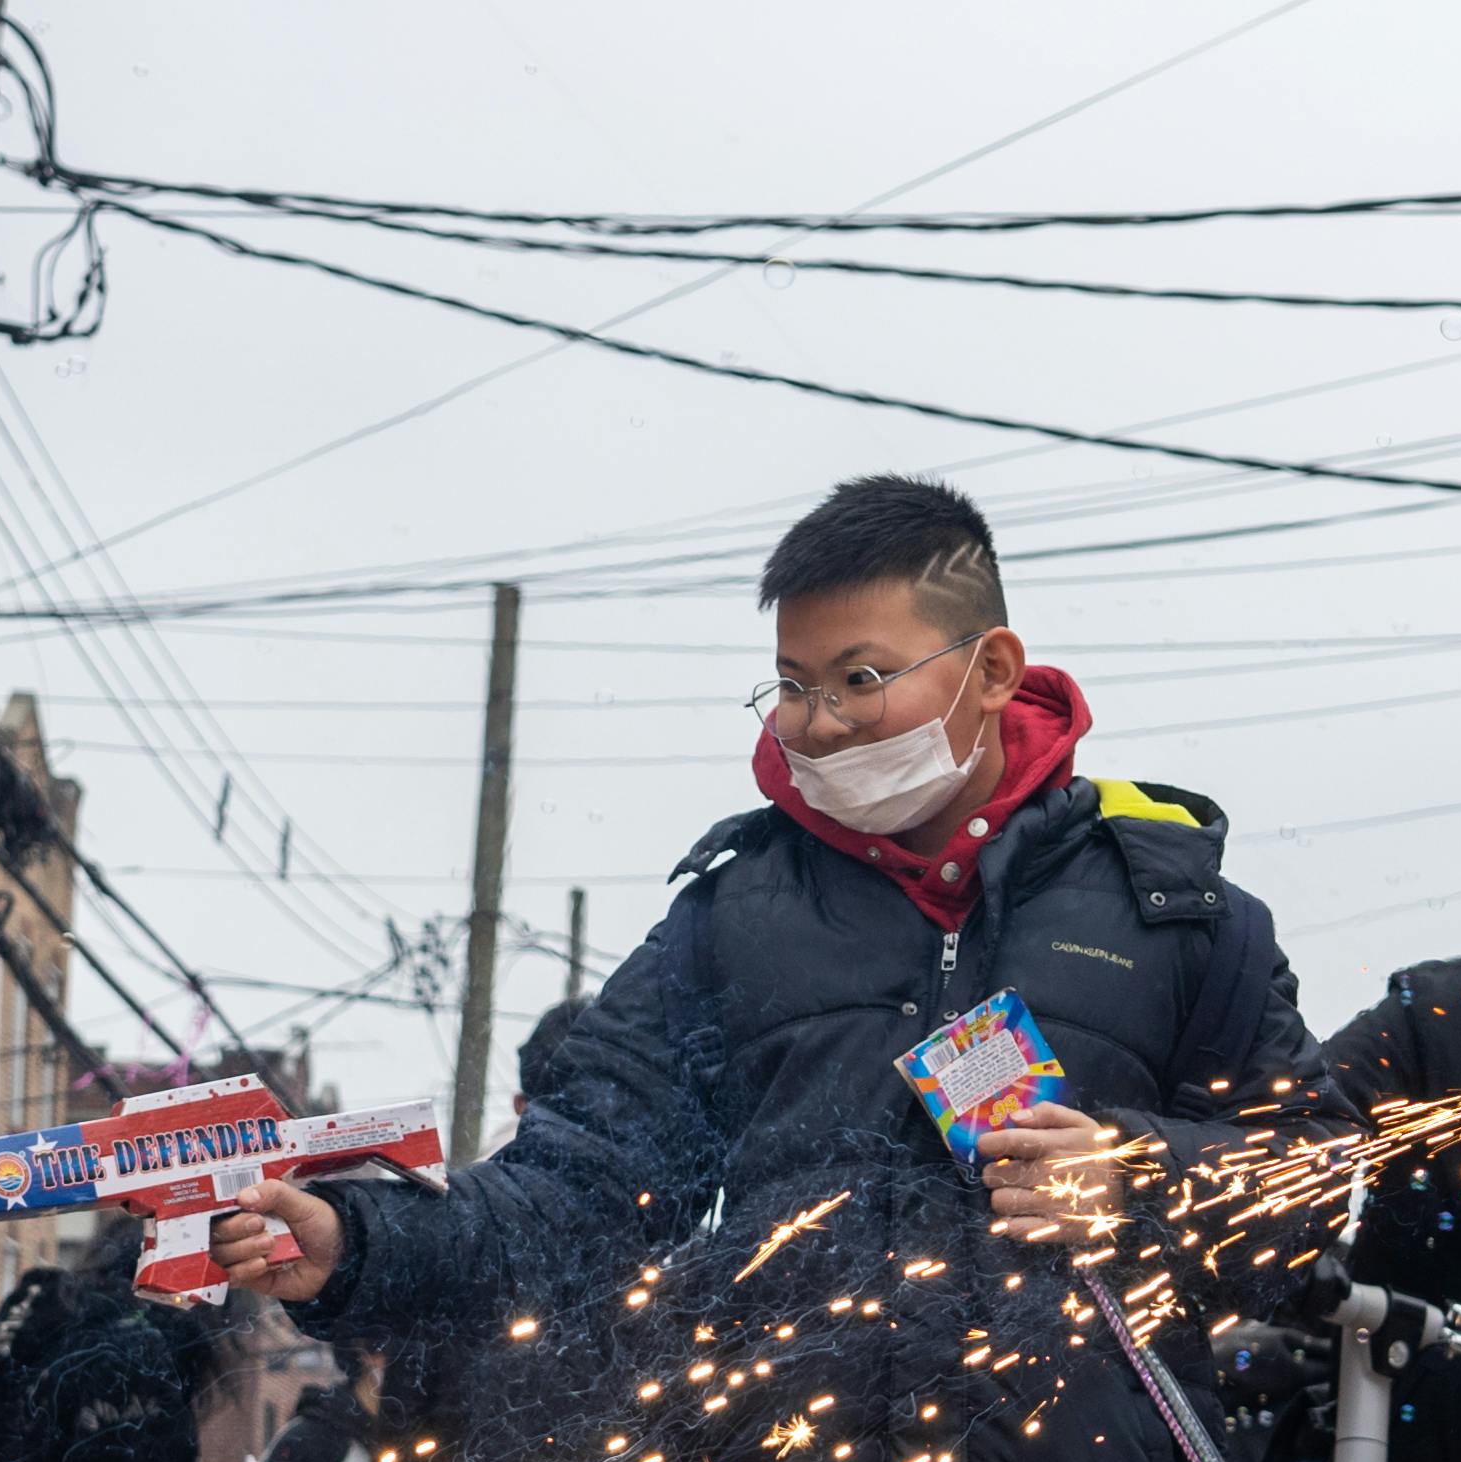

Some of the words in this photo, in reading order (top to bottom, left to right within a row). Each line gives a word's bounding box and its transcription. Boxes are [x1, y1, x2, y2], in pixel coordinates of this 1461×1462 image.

[1051, 941, 1083, 956] CALVIN
[1083, 947, 1108, 961] KLEIN
[1108, 952, 1135, 969] JEANS
[34, 1143, 105, 1190] THE
[112, 1116, 283, 1176] DEFENDER
